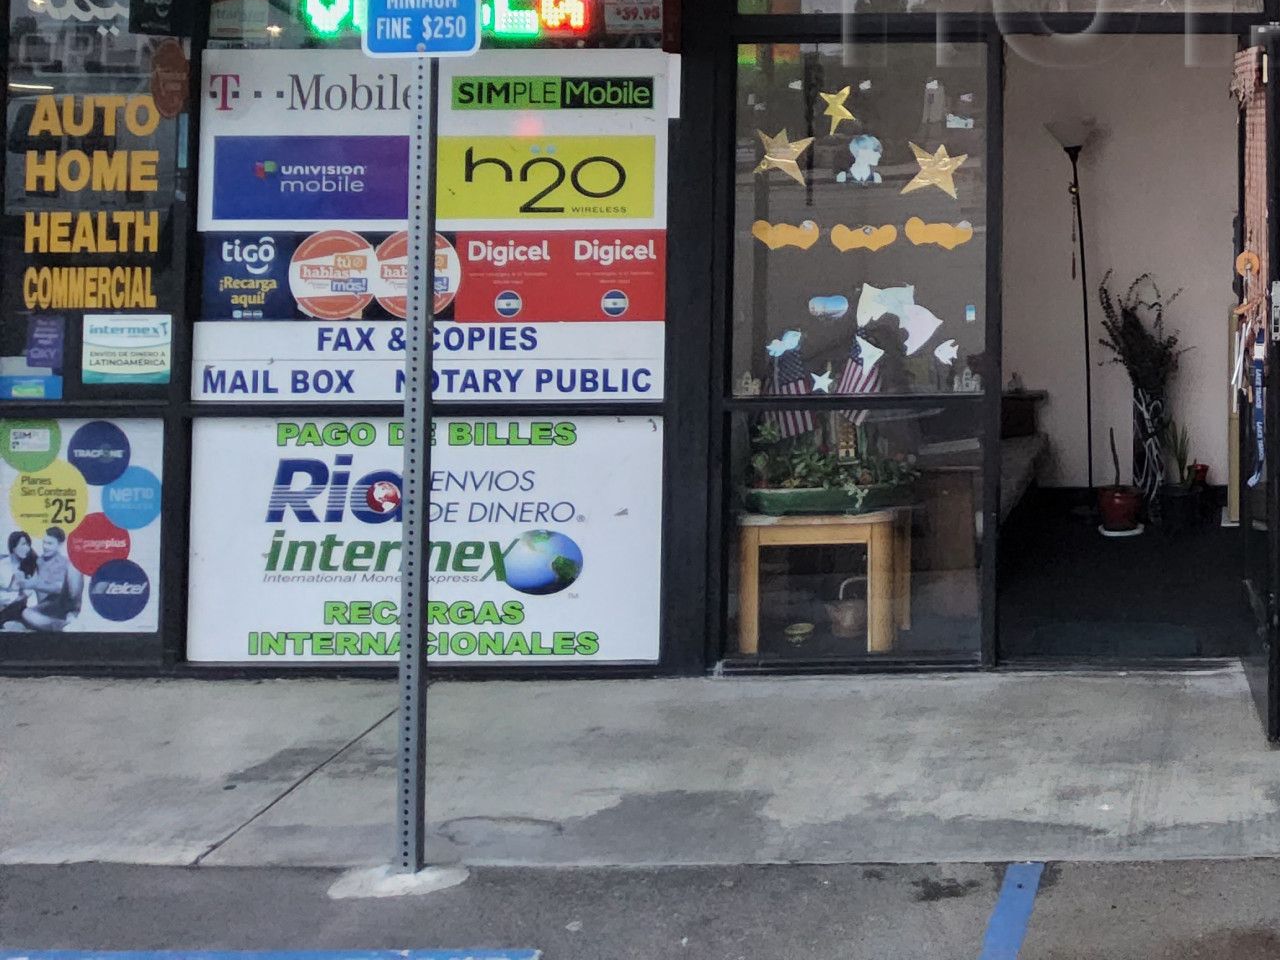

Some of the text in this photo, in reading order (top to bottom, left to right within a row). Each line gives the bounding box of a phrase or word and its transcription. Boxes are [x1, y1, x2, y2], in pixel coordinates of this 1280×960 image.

[376, 14, 467, 41] FINE $250
[457, 81, 651, 105] SIMPLE Mobile
[28, 94, 161, 137] AUTO
[24, 149, 160, 192] HOME
[281, 164, 366, 176] univision
[280, 176, 365, 193] mobile
[571, 206, 627, 214] WIRELESS
[24, 210, 159, 253] HEALTH
[467, 239, 551, 267] Digicel
[574, 238, 657, 266] Digicel
[22, 266, 158, 310] COMMERCIAL
[317, 326, 376, 352] FAX
[202, 369, 279, 394] MAIL
[290, 369, 356, 394] BOX
[535, 368, 652, 394] PUBLIC
[276, 422, 377, 447] PAGO
[448, 421, 578, 446] BILLES
[21, 475, 51, 486] Planes
[21, 486, 77, 497] Sin Contrato
[264, 453, 406, 524] Ria
[430, 470, 536, 492] ENVIOS
[468, 501, 577, 523] DINERO
[263, 573, 480, 584] International Mone xpress
[323, 600, 526, 626] RECRGAS
